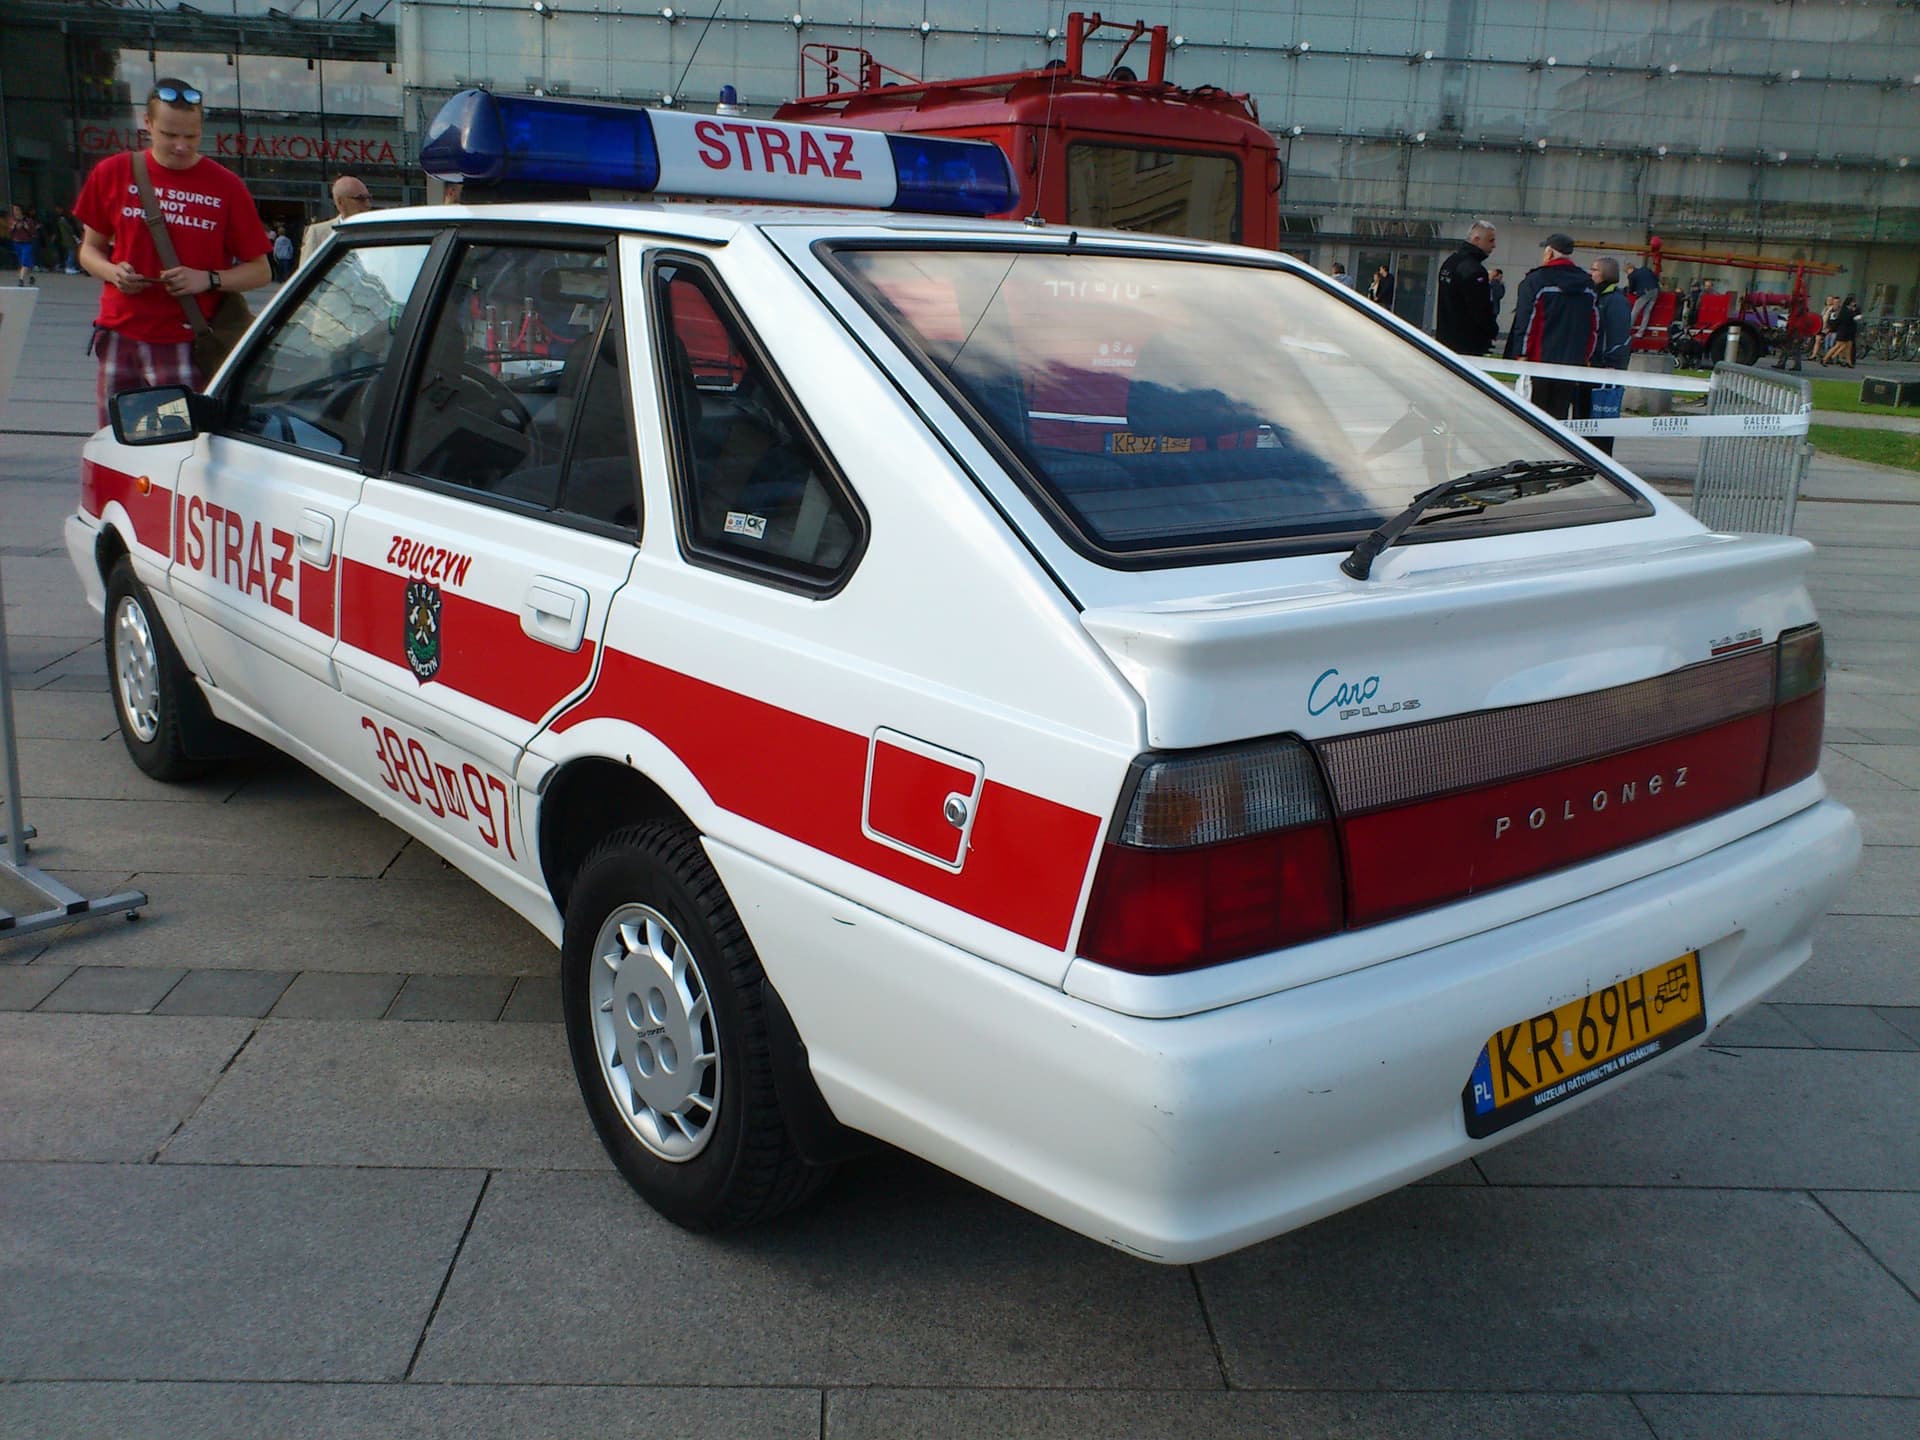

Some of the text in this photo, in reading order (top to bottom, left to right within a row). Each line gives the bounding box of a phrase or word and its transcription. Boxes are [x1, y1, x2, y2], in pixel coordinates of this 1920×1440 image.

[215, 132, 397, 164] KRAKOWSKA
[128, 184, 222, 209] ON SOURCE
[159, 200, 187, 213] NOT
[164, 212, 217, 231] WALLET
[1652, 417, 1689, 428] GALERIA
[1743, 415, 1781, 425] GALERIA
[386, 535, 473, 587] ZBUCZYN
[1307, 668, 1380, 716] Caro
[1339, 699, 1422, 721] PLUS
[1473, 972, 1651, 1105] PL KR 69H
[1534, 1084, 1568, 1106] MUZEUM
